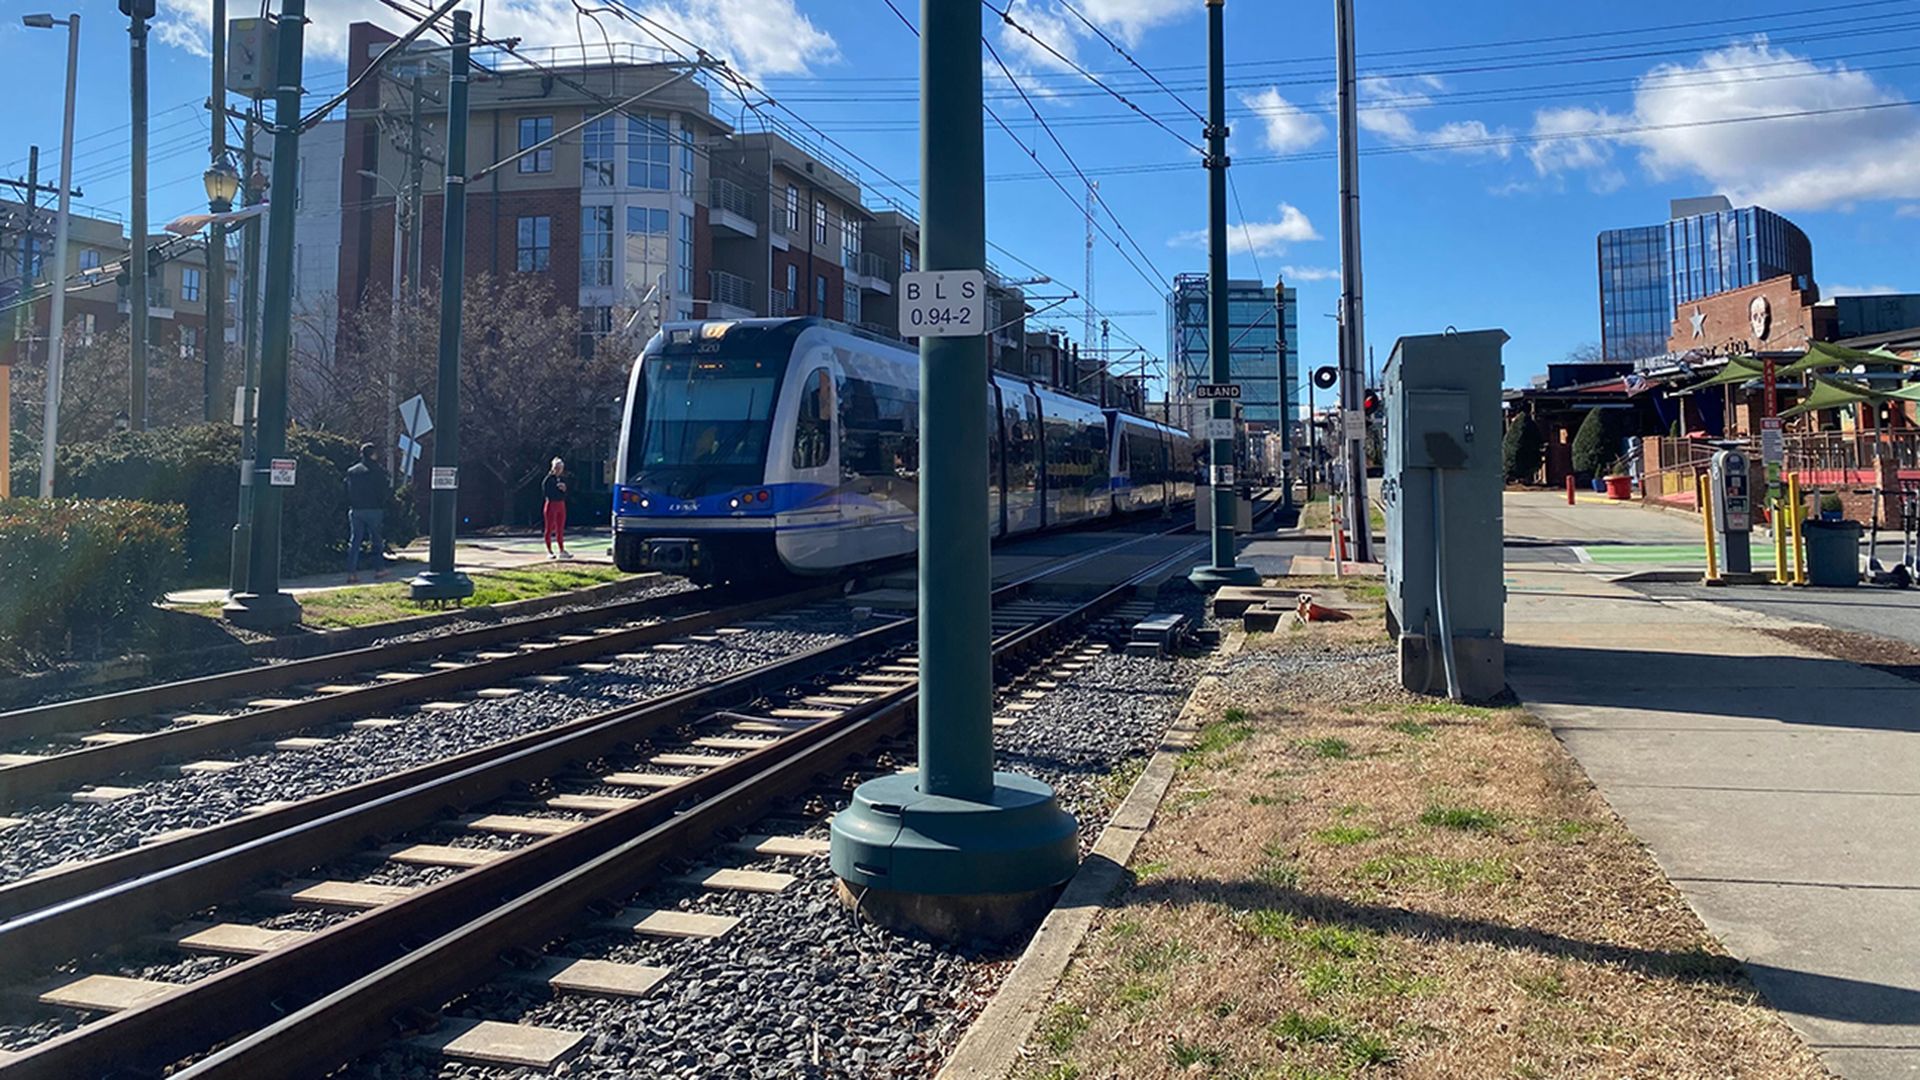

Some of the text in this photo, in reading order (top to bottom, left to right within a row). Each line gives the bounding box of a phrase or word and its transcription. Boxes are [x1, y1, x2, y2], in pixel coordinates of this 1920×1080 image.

[907, 281, 975, 300] B L S
[911, 307, 971, 325] 0.94-2
[699, 344, 720, 352] 320
[1198, 387, 1239, 397] BLAND
